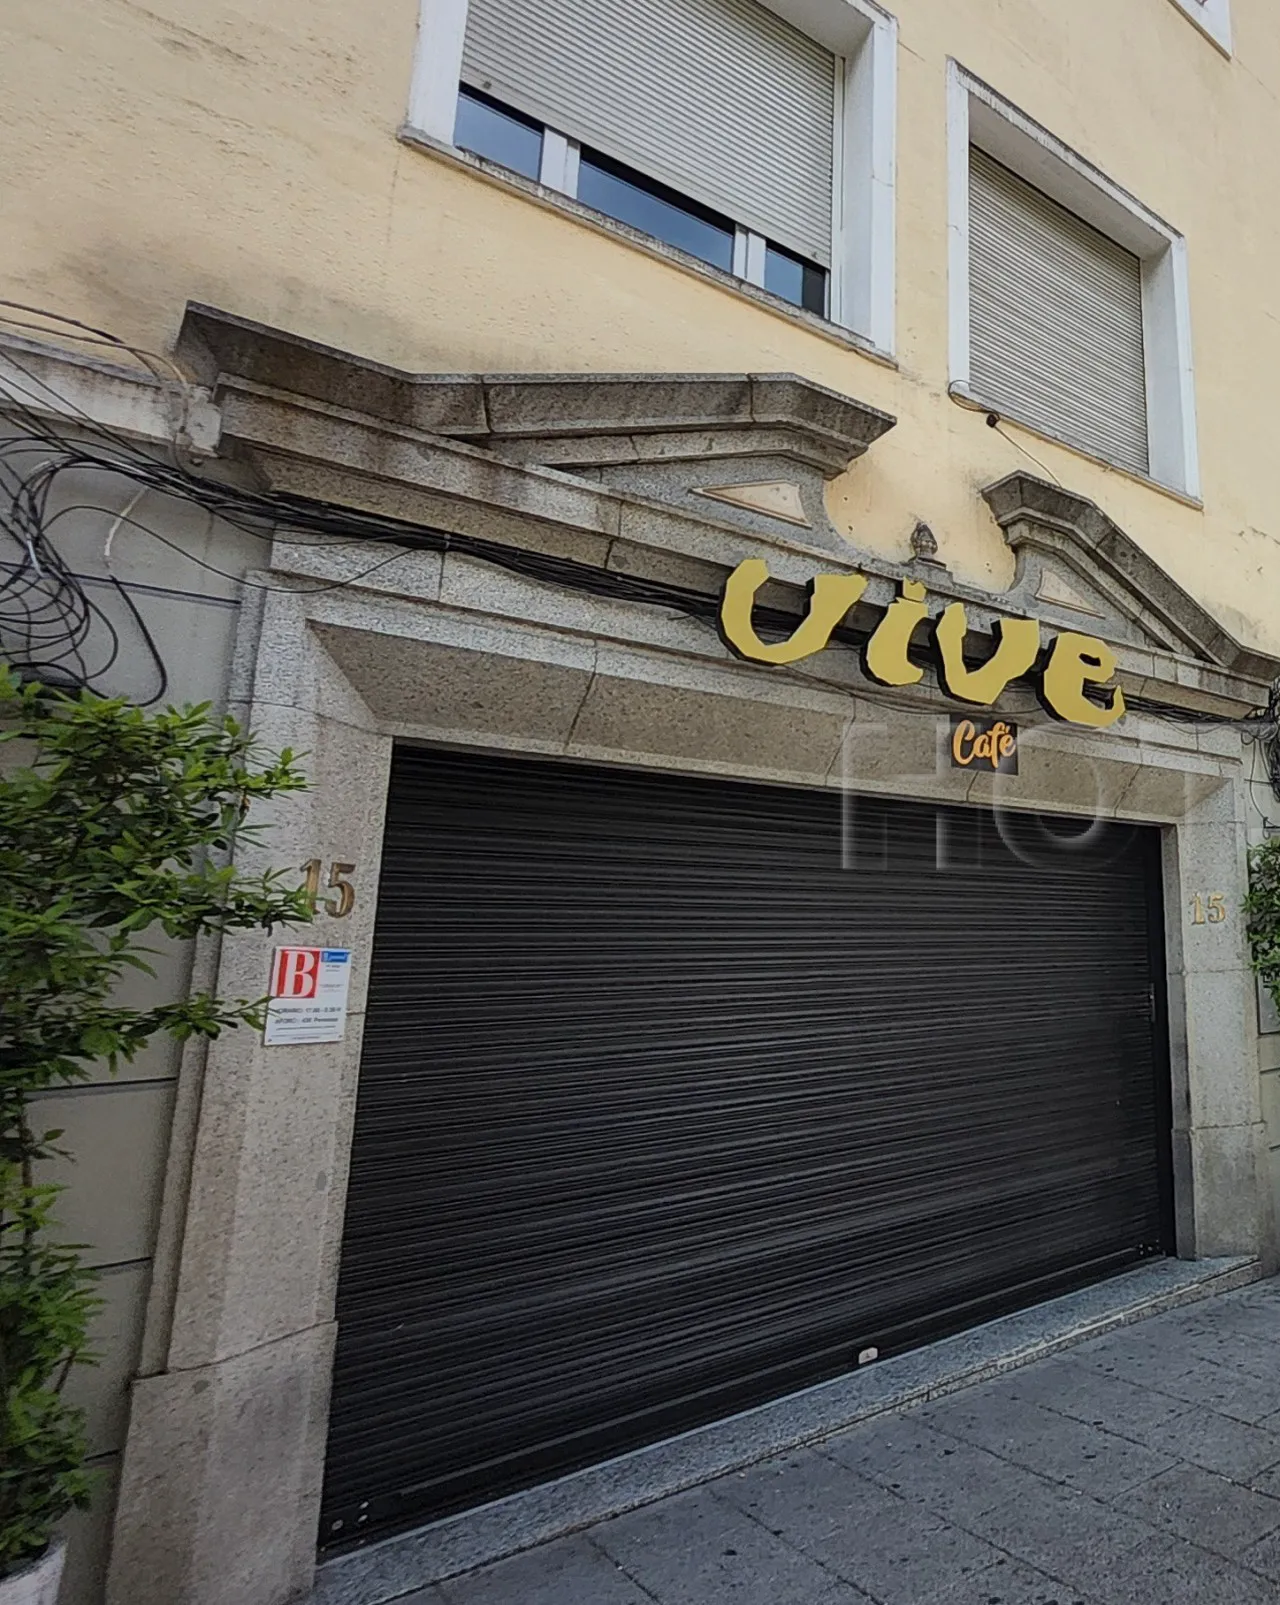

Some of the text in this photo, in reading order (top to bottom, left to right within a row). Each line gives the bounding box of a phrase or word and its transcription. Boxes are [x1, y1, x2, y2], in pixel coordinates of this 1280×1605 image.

[953, 719, 1017, 769] Café
[300, 858, 356, 919] 15
[1188, 892, 1226, 926] 15
[278, 950, 316, 998] B
